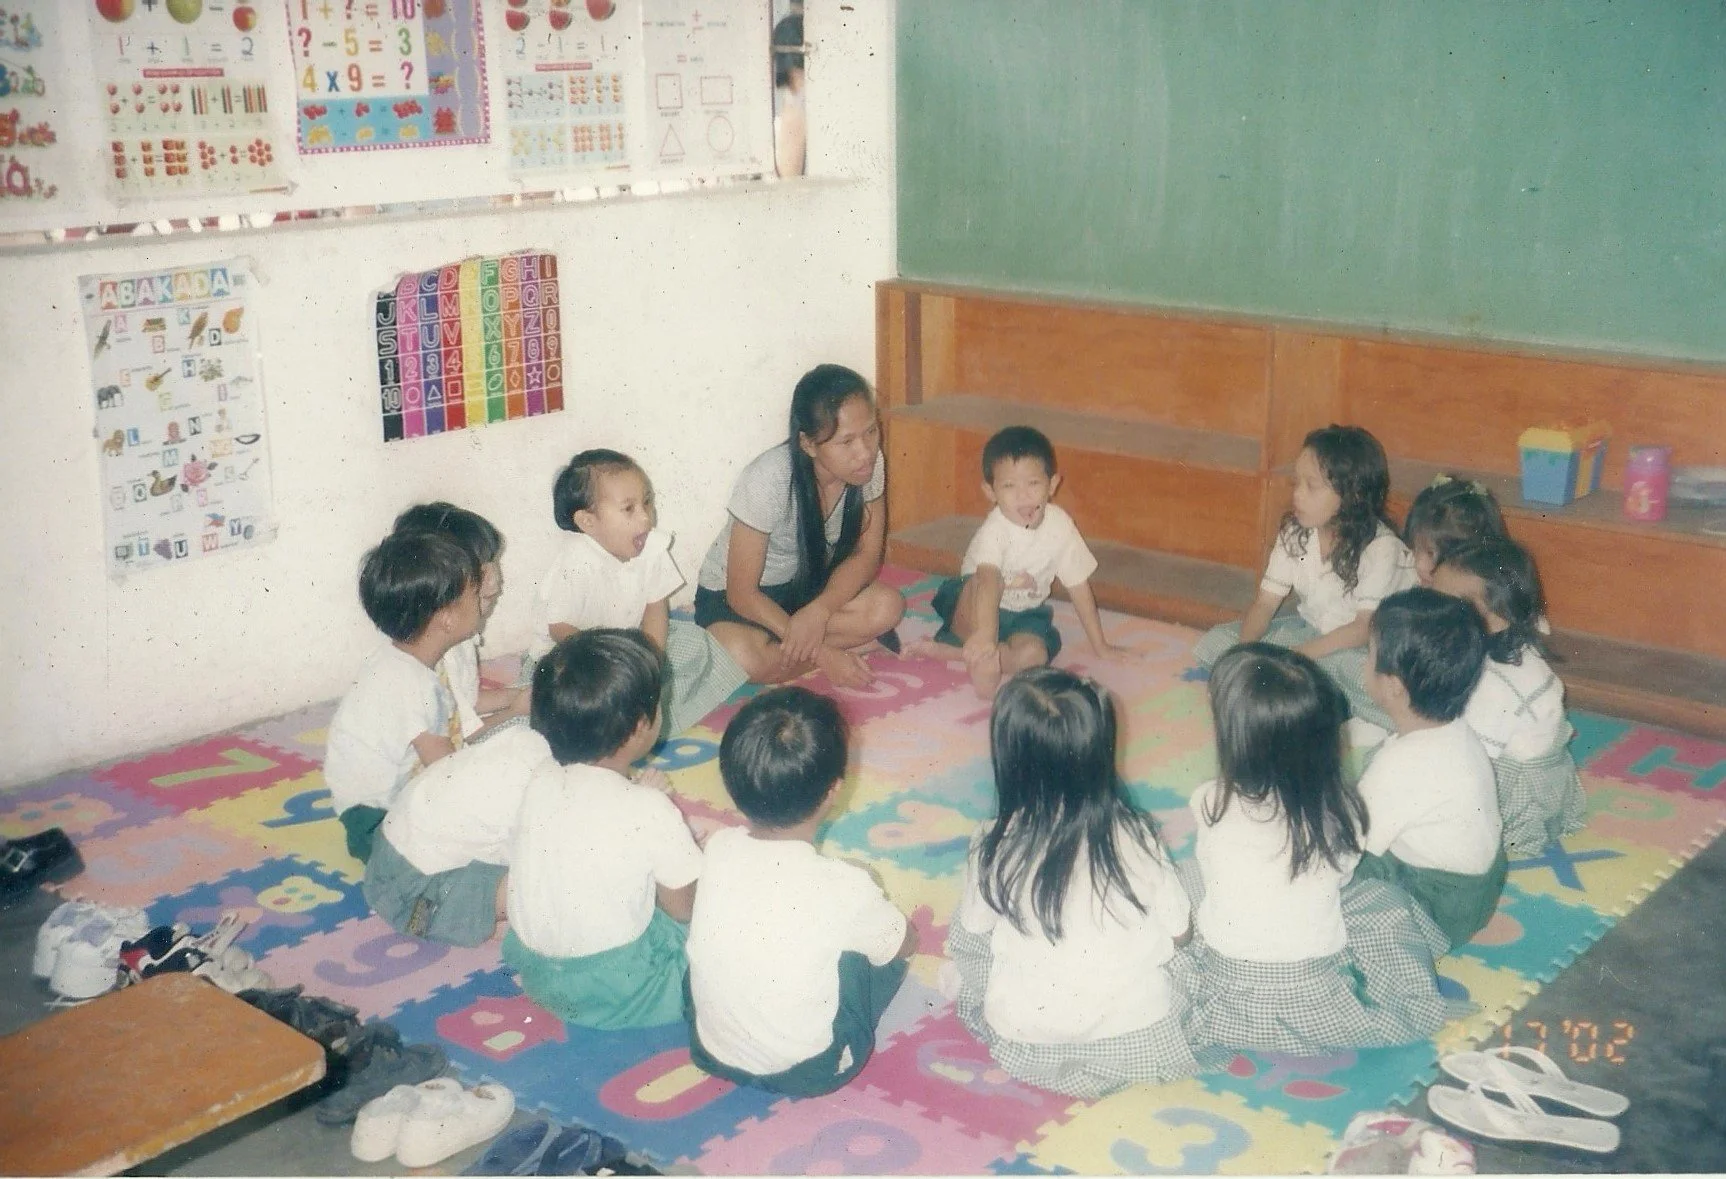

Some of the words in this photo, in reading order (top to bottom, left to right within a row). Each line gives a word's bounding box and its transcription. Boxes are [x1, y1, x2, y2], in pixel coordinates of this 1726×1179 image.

[241, 36, 254, 56] 2
[298, 28, 312, 57] ?
[344, 28, 359, 56] 5
[398, 28, 412, 56] 3
[302, 65, 317, 92] 4
[347, 63, 362, 91] 9
[401, 61, 413, 90] ?
[421, 271, 438, 292] C
[441, 267, 457, 291] D
[481, 261, 498, 285] F
[502, 258, 518, 282] G
[522, 257, 539, 281] H
[100, 268, 230, 309] ABAKADA
[377, 302, 395, 326] J
[401, 298, 418, 323] K
[421, 297, 438, 320] L
[442, 293, 461, 317] M
[503, 286, 518, 310] P
[523, 284, 540, 308] Q
[542, 282, 558, 306] R
[209, 328, 221, 346] D
[379, 330, 397, 355] S
[402, 327, 418, 351] T
[423, 324, 440, 349] U
[443, 321, 461, 345] V
[484, 315, 501, 340] X
[504, 313, 520, 336] Y
[525, 311, 540, 334] Z
[152, 335, 166, 353] B
[384, 359, 394, 382] 1
[405, 356, 418, 378] 2
[426, 353, 439, 376] 3
[446, 350, 461, 371] 4
[489, 344, 500, 366] 6
[508, 341, 519, 364] 7
[528, 338, 540, 361] 8
[547, 335, 558, 357] 9
[383, 387, 401, 411] 10
[188, 416, 202, 436] N
[127, 428, 140, 446] L
[163, 449, 179, 467] M
[230, 519, 242, 536] Y
[175, 540, 188, 559] U
[203, 533, 219, 552] W
